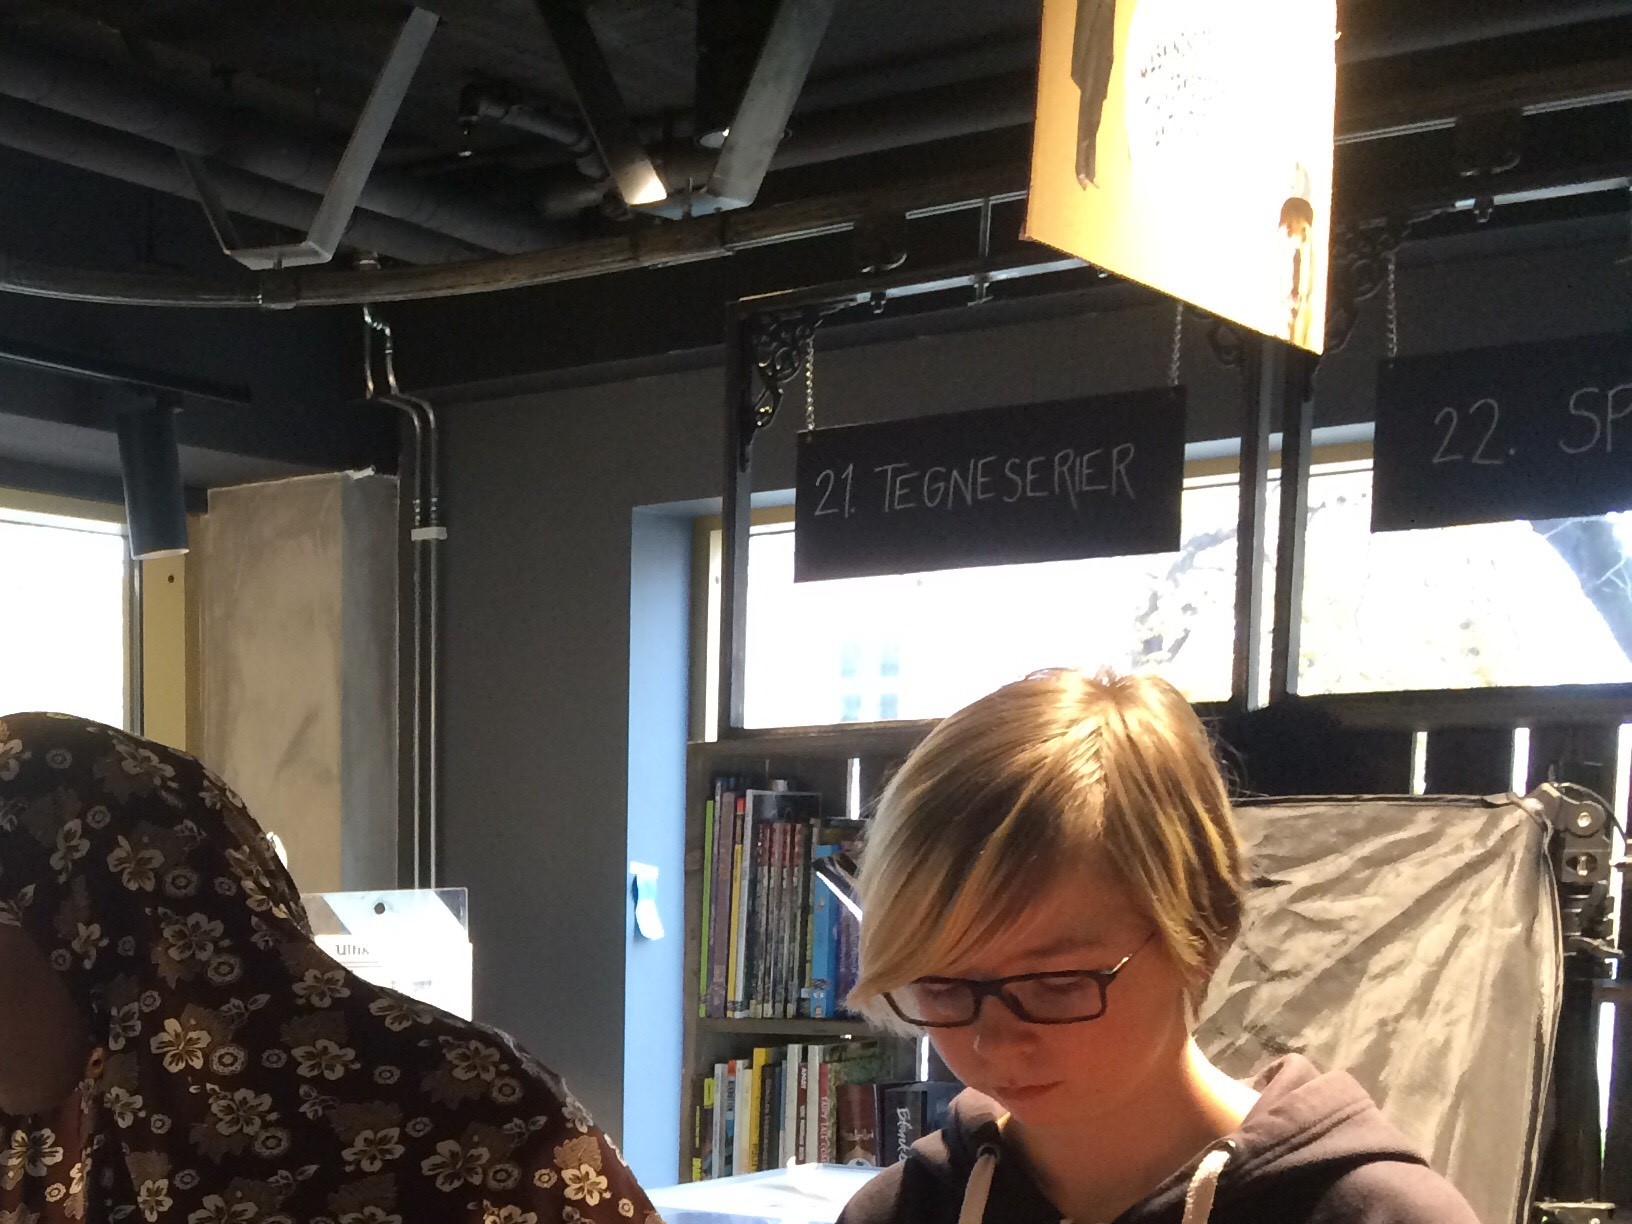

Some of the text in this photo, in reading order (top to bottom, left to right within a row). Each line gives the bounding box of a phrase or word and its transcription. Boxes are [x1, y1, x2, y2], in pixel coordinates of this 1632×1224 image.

[1431, 398, 1516, 465] 22.
[814, 443, 1137, 519] 21. TEGNESERIER
